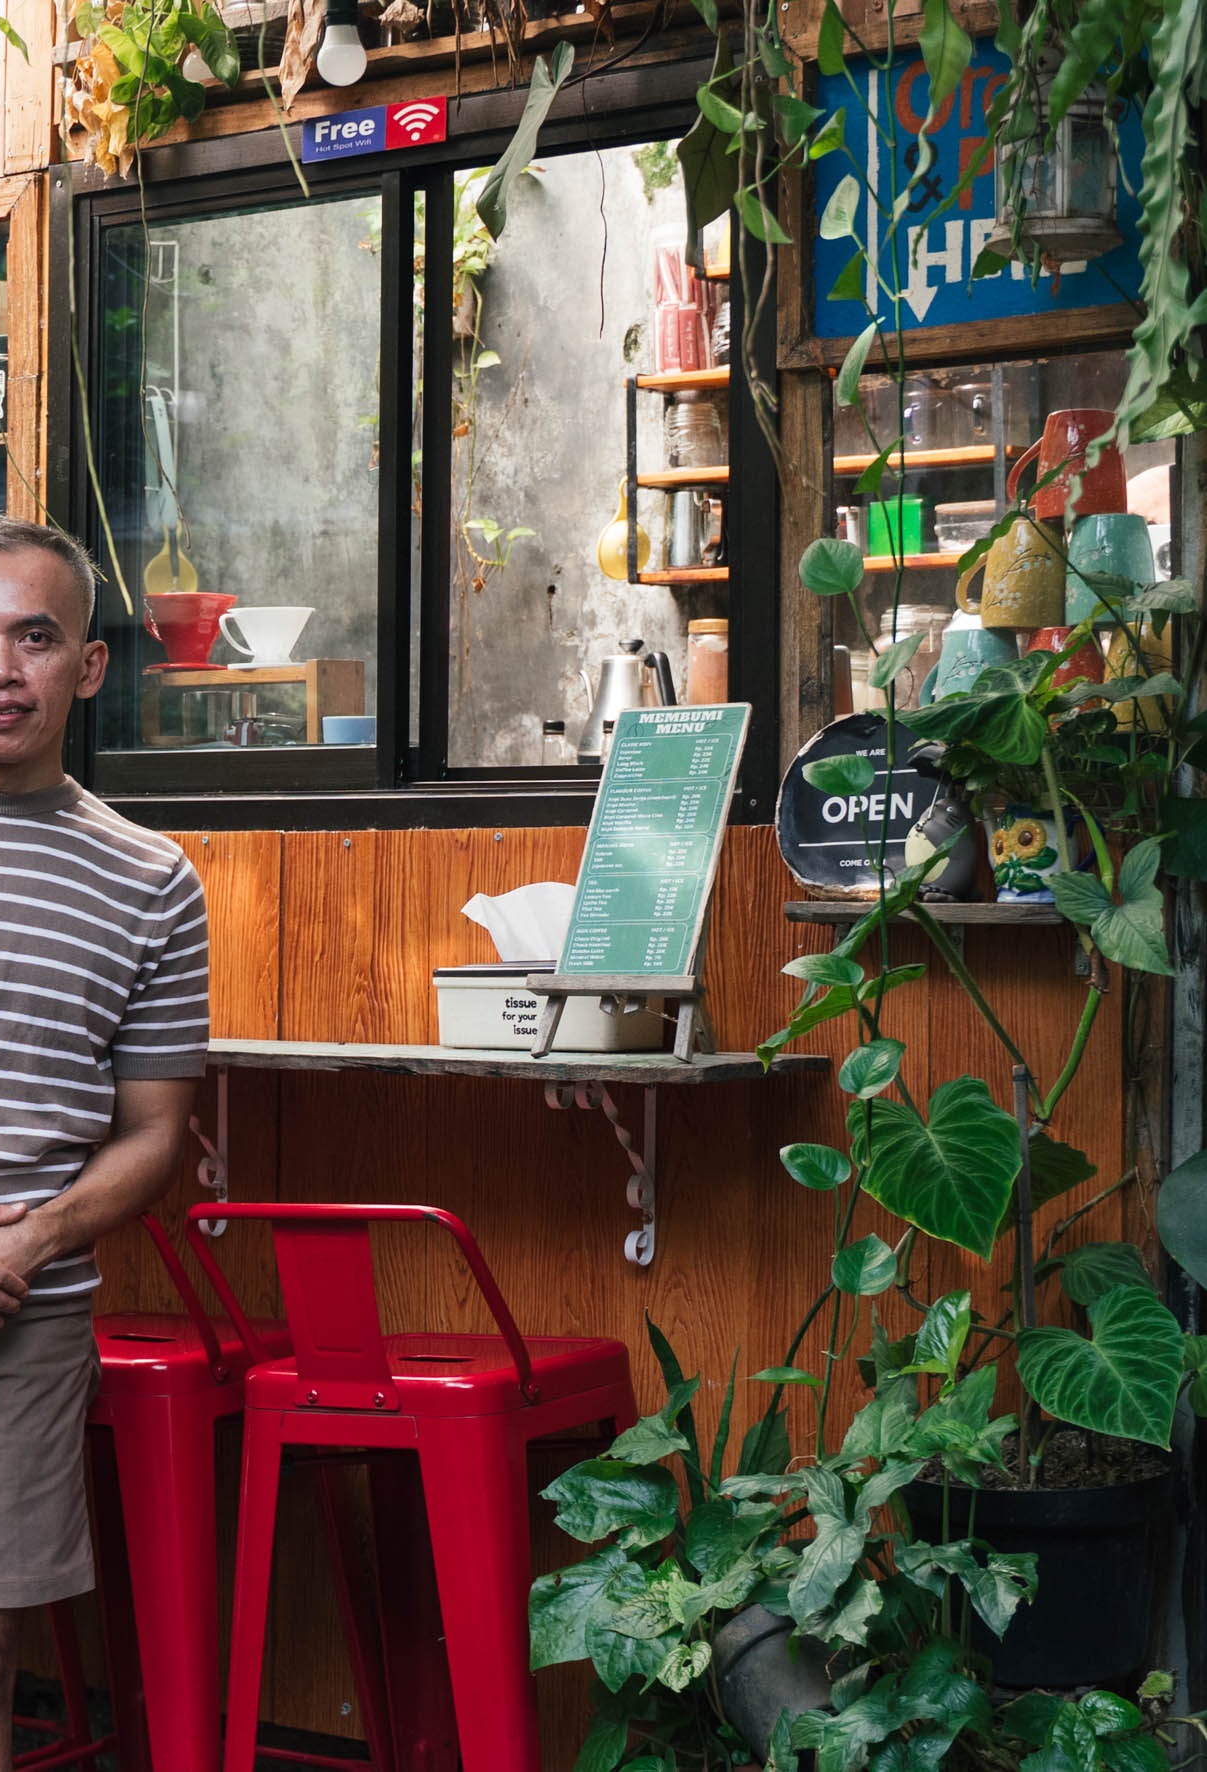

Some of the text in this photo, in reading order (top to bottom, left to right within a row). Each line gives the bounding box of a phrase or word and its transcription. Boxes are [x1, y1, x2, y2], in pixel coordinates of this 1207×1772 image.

[315, 118, 375, 143] Free
[316, 138, 372, 153] Hot Spot Wifi
[639, 710, 724, 724] MEMBUMI
[655, 722, 706, 734] MENU
[855, 748, 887, 757] WE ARE
[822, 791, 914, 824] OPEN
[839, 859, 863, 868] COME
[504, 996, 537, 1009] tissue
[502, 1011, 537, 1022] for your
[513, 1024, 538, 1036] issue
